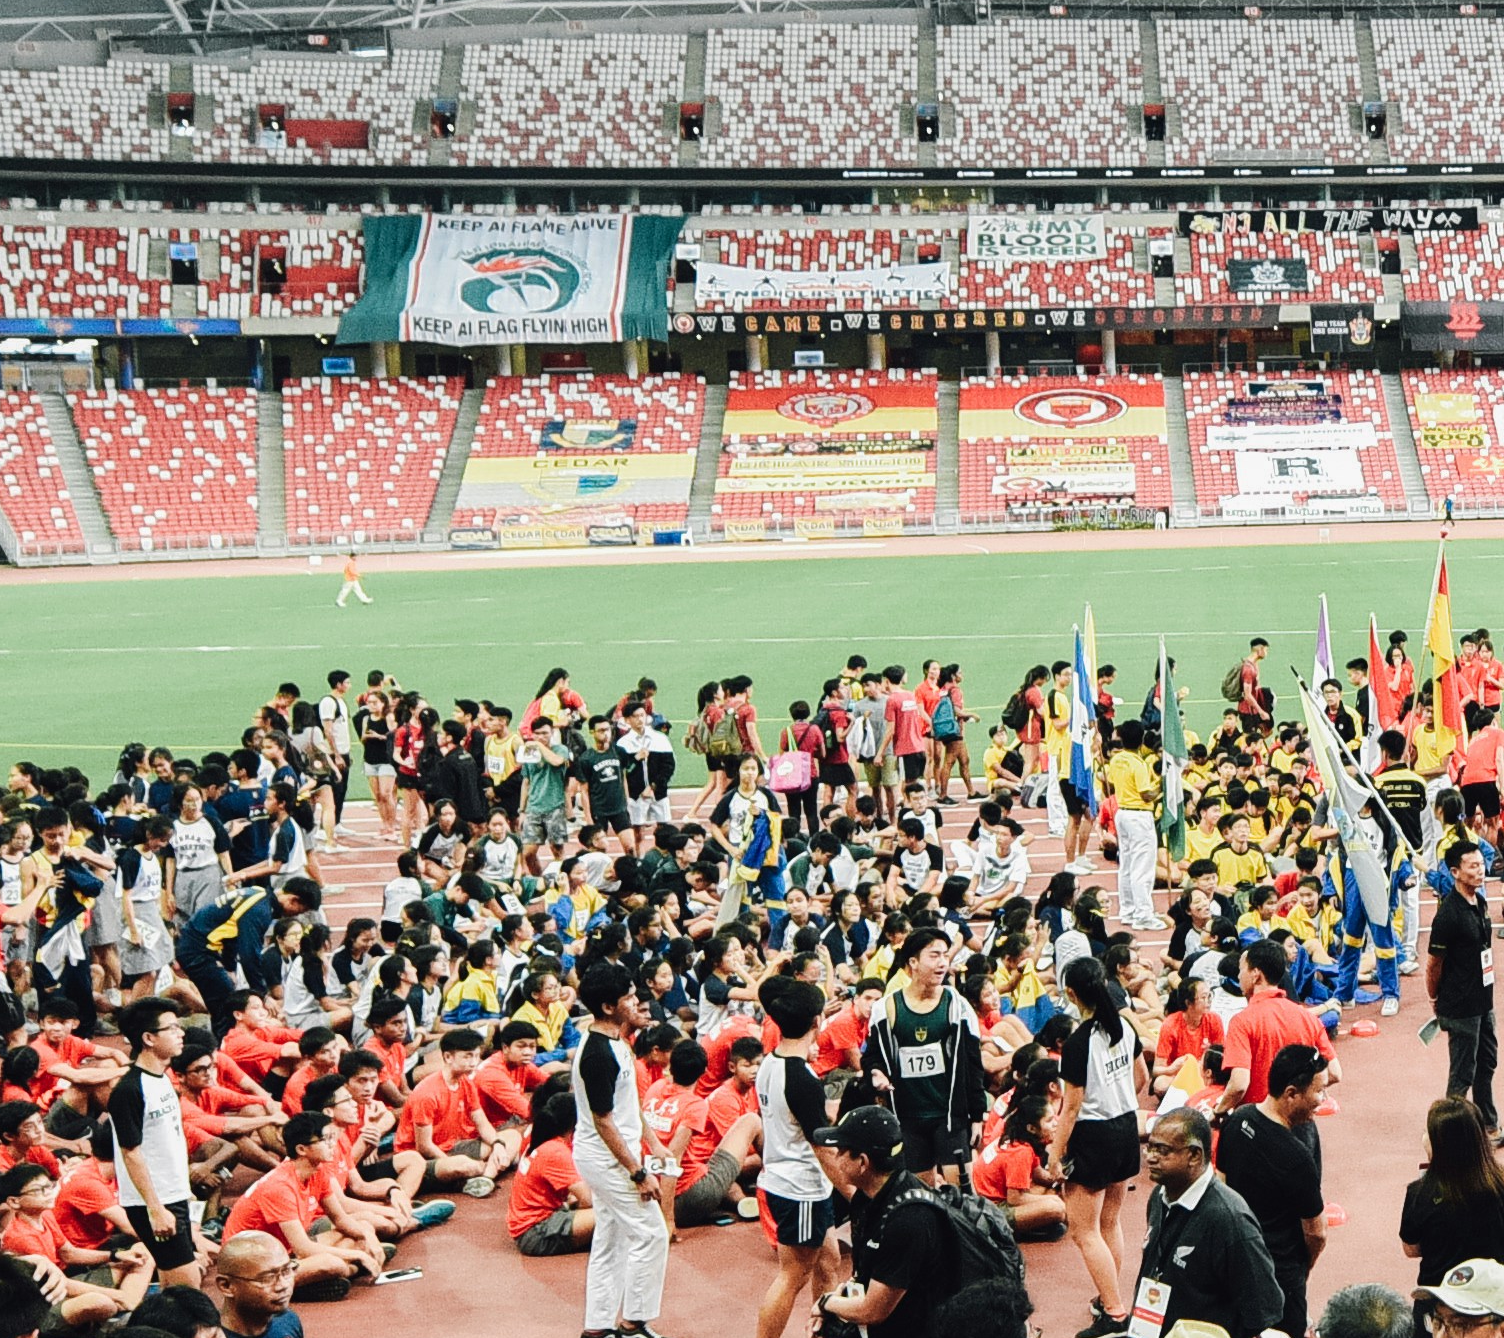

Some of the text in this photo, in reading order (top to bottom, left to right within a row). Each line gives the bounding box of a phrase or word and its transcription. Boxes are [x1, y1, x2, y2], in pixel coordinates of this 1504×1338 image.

[306, 216, 322, 226] 417
[1264, 211, 1315, 233] ALL
[1323, 210, 1370, 232] THE
[1383, 209, 1433, 229] WAY
[1486, 210, 1501, 219] 412
[437, 218, 617, 236] KEEP AI FLAME ALIVE
[1026, 219, 1092, 234] #MY
[978, 233, 1096, 248] BLOOD
[978, 245, 1097, 258] IS GREEN
[413, 316, 453, 334] KEEP
[458, 319, 473, 336] AI
[478, 318, 518, 336] FLAG
[570, 317, 608, 335] HIGH
[697, 310, 1086, 332] WE CAME WE CHEERED WE
[533, 458, 629, 469] CEDAR
[726, 523, 764, 533] CEDAR
[797, 522, 832, 531] CEDAR
[503, 530, 541, 539] CEDAR
[545, 529, 583, 538] CEDAR
[908, 1055, 935, 1072] 179
